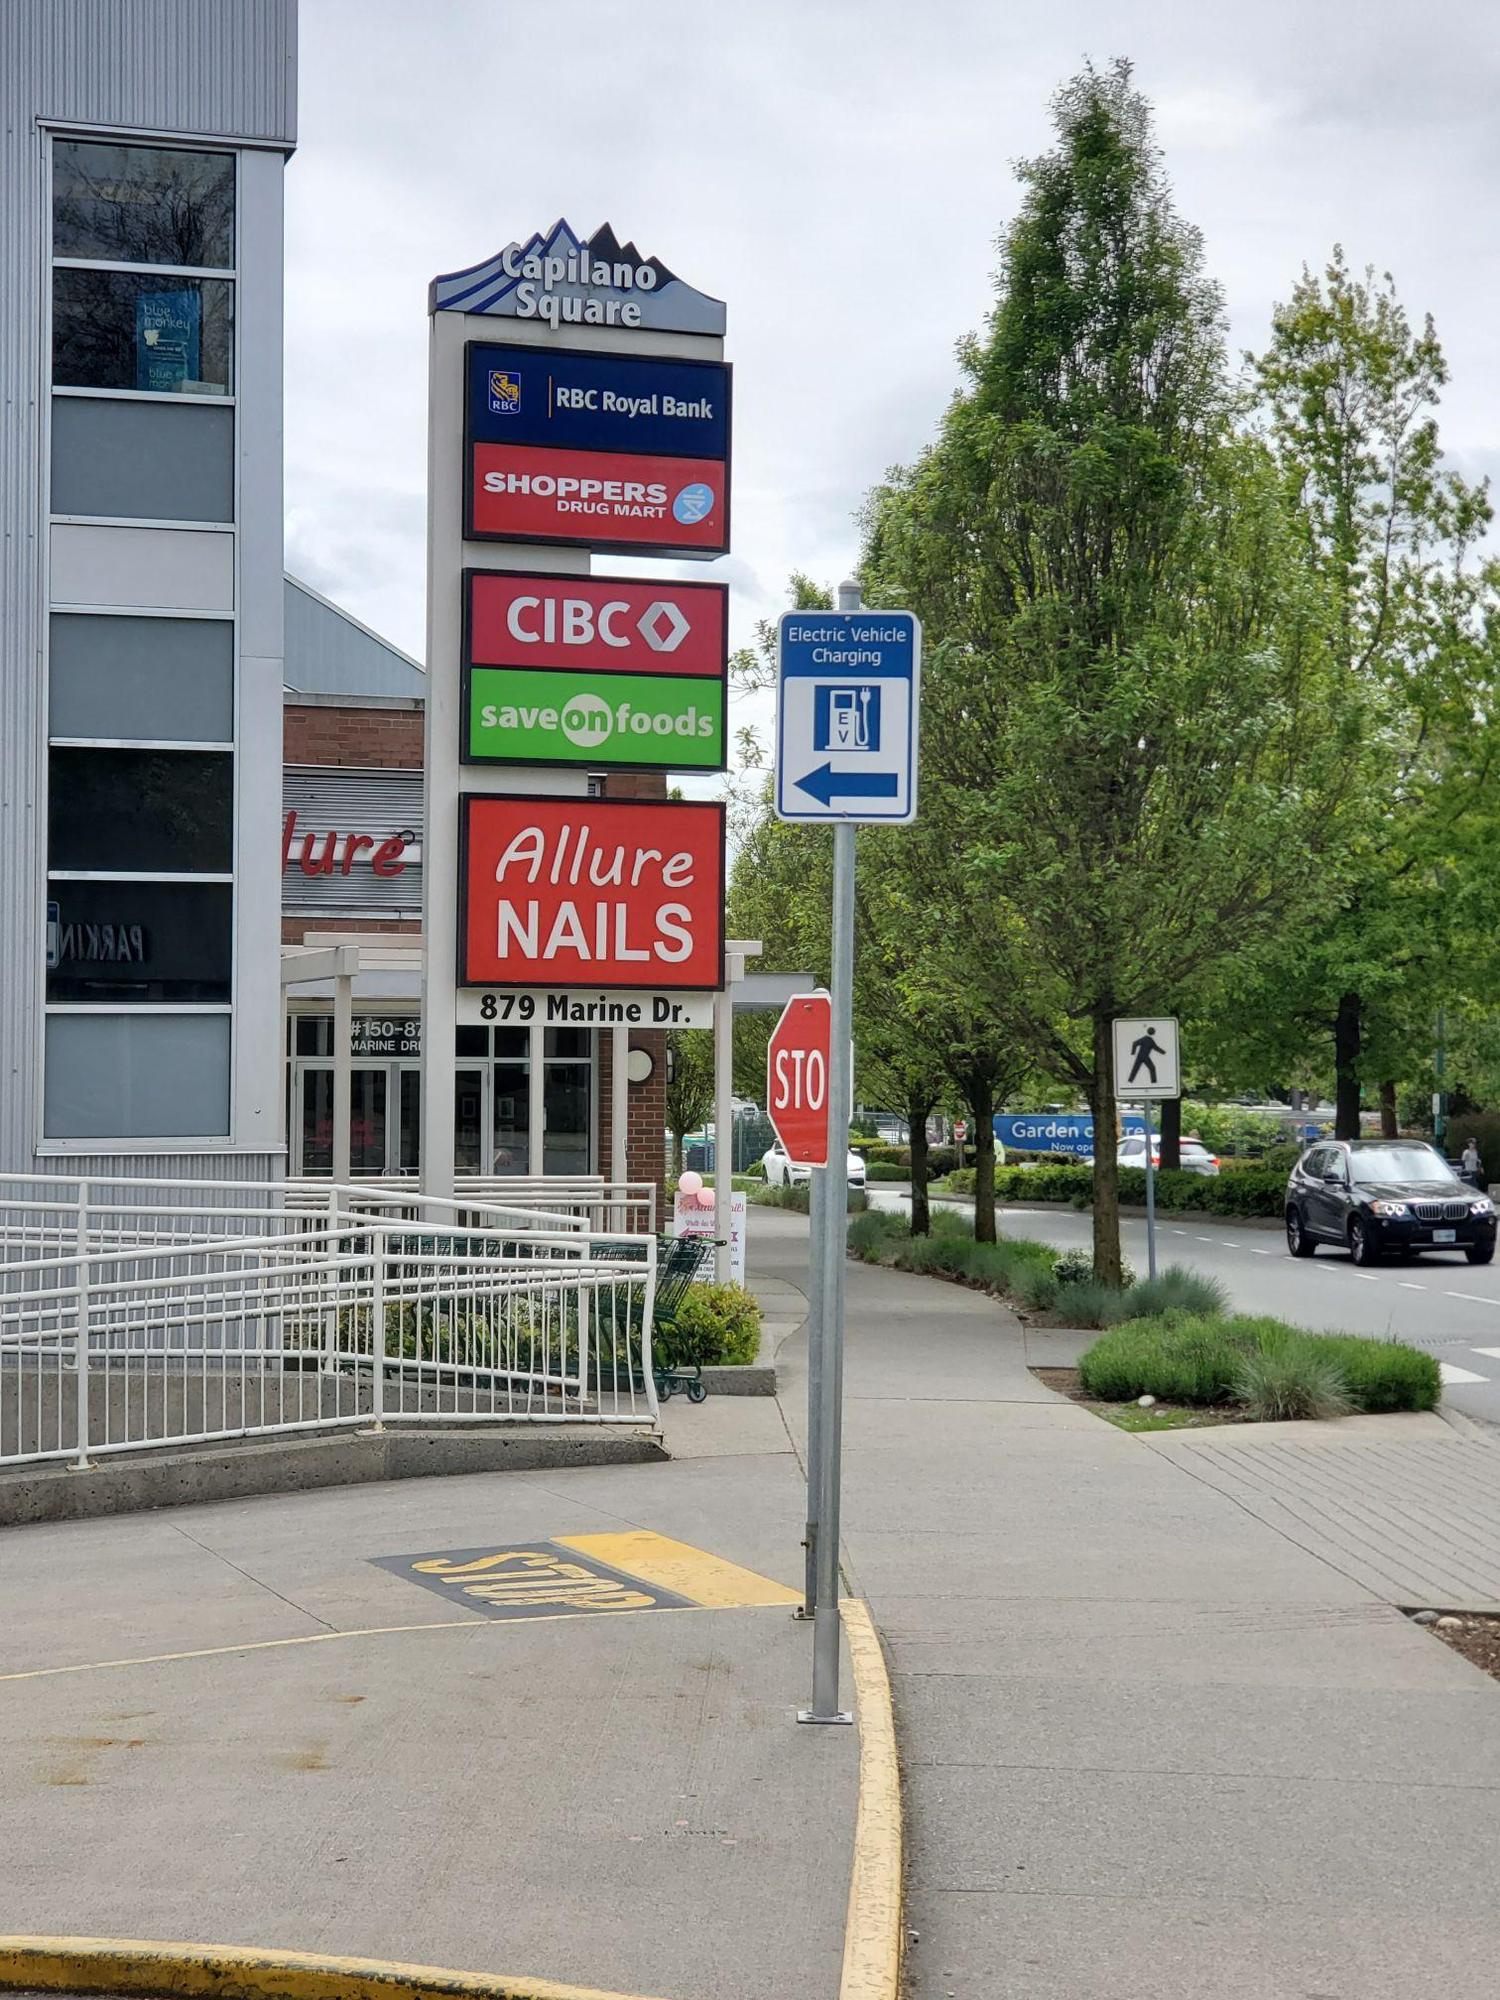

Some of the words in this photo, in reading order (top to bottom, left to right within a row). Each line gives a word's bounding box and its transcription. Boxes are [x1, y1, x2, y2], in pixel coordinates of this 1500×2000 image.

[502, 249, 657, 291] Capilano
[144, 303, 170, 317] blue
[516, 282, 641, 330] Square
[492, 400, 518, 411] RBC
[556, 387, 598, 410] RBC
[602, 391, 658, 418] Royal
[662, 396, 713, 419] Bank
[483, 472, 668, 503] SHOPPERS
[557, 500, 609, 515] DRUG
[614, 503, 667, 518] MART
[506, 596, 632, 647] CIBC
[788, 627, 846, 642] Electric
[851, 627, 907, 642] Vehicle
[812, 648, 882, 666] Charging
[282, 810, 406, 878] lure
[495, 824, 695, 888] Allure
[497, 899, 694, 963] NAILS
[480, 994, 535, 1020] 879
[547, 994, 641, 1023] Marine
[652, 996, 691, 1023] Dr.
[351, 1021, 421, 1037] #150-87
[351, 1040, 396, 1051] MARINE
[400, 1040, 420, 1051] DRI
[775, 1049, 825, 1110] STO
[1012, 1121, 1079, 1138] Garden
[1051, 1142, 1074, 1151] Now
[411, 1551, 657, 1609] STOP
